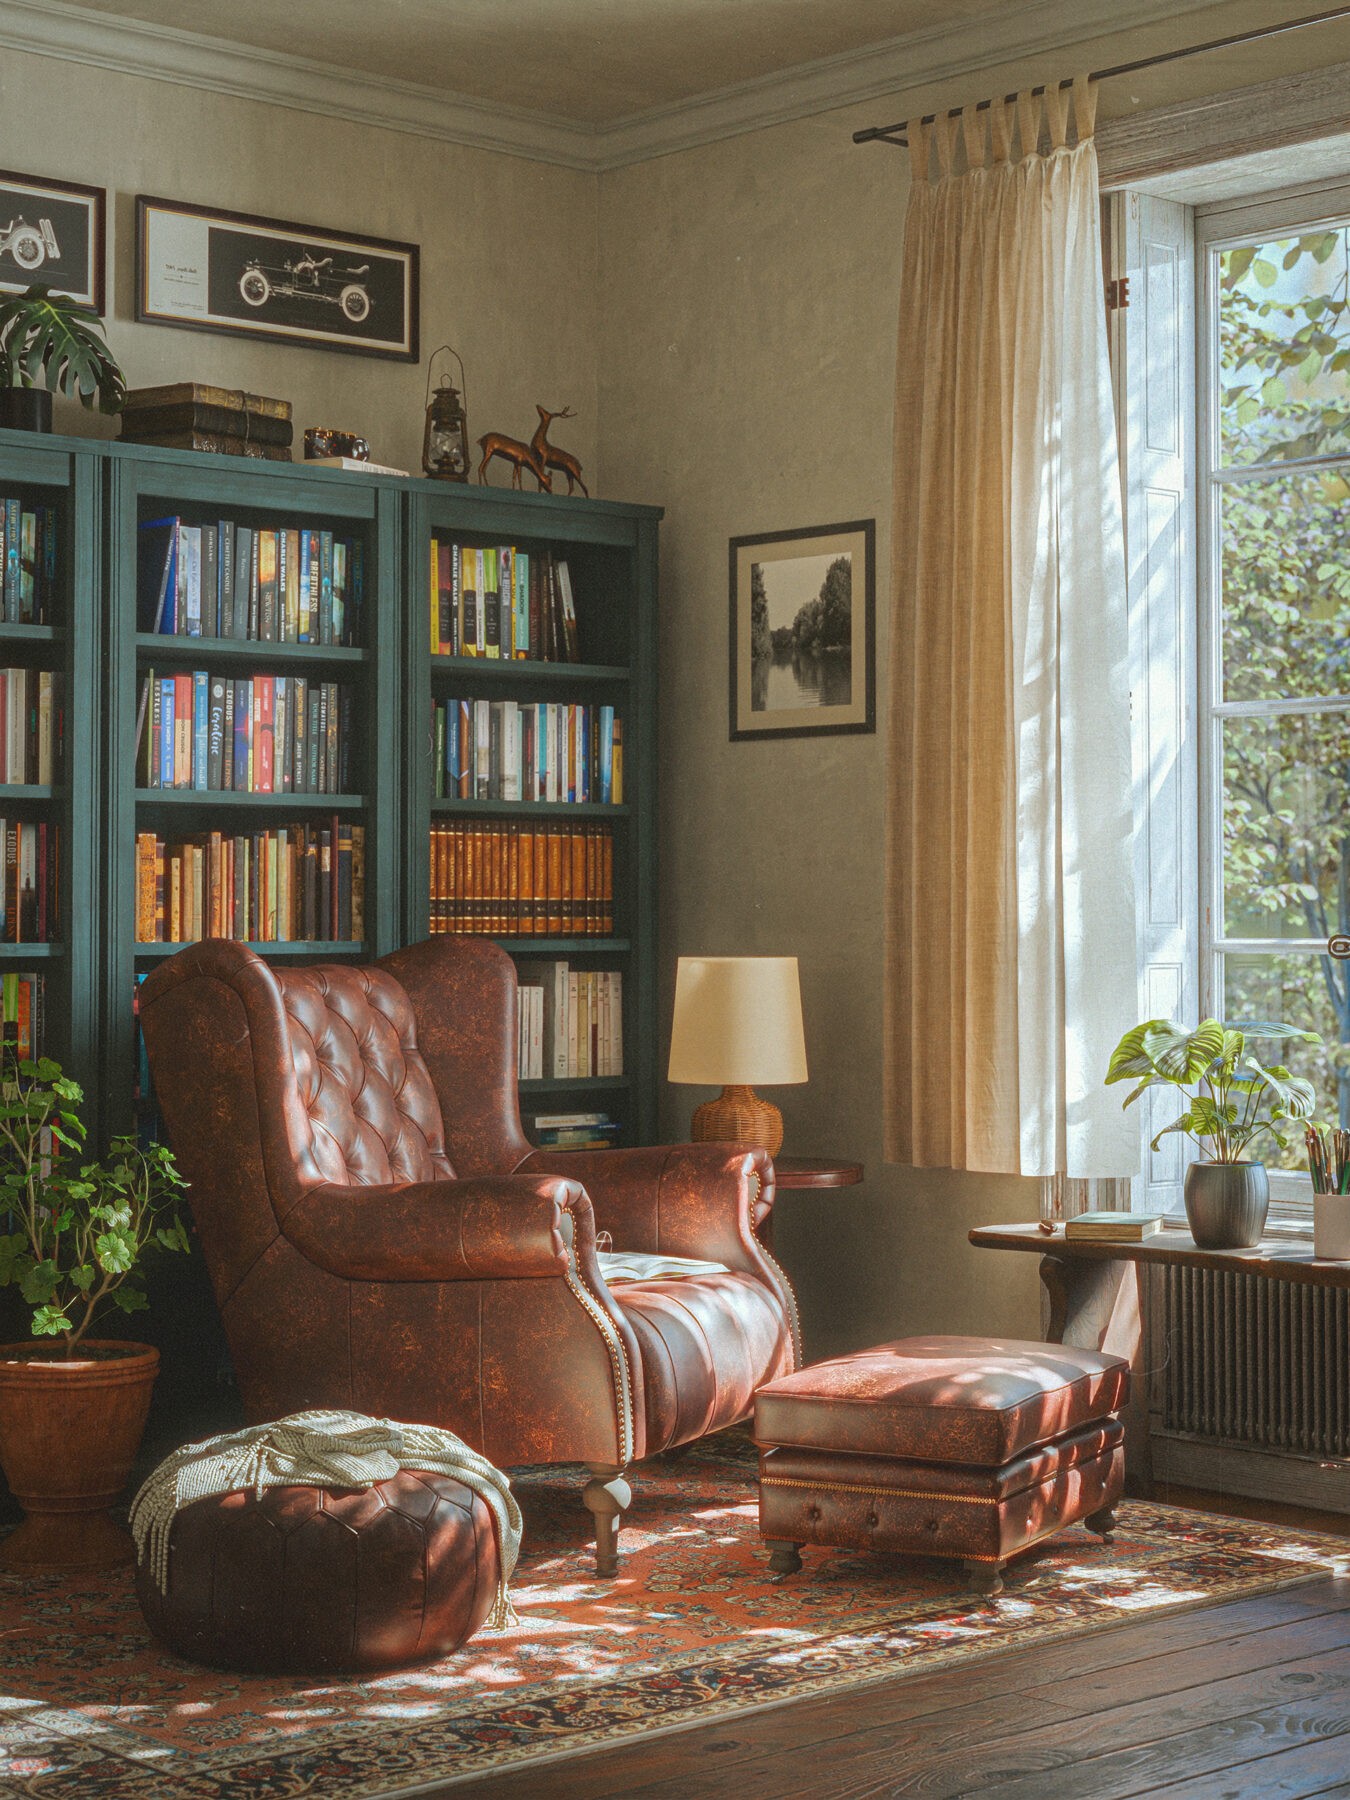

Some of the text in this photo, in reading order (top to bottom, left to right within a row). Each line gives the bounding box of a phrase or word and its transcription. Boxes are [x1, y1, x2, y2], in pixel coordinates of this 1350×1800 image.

[223, 568, 231, 594] CANDLES
[309, 560, 319, 613] BREATHLESS
[225, 689, 233, 721] EXODUS
[6, 830, 17, 865] EXODUS
